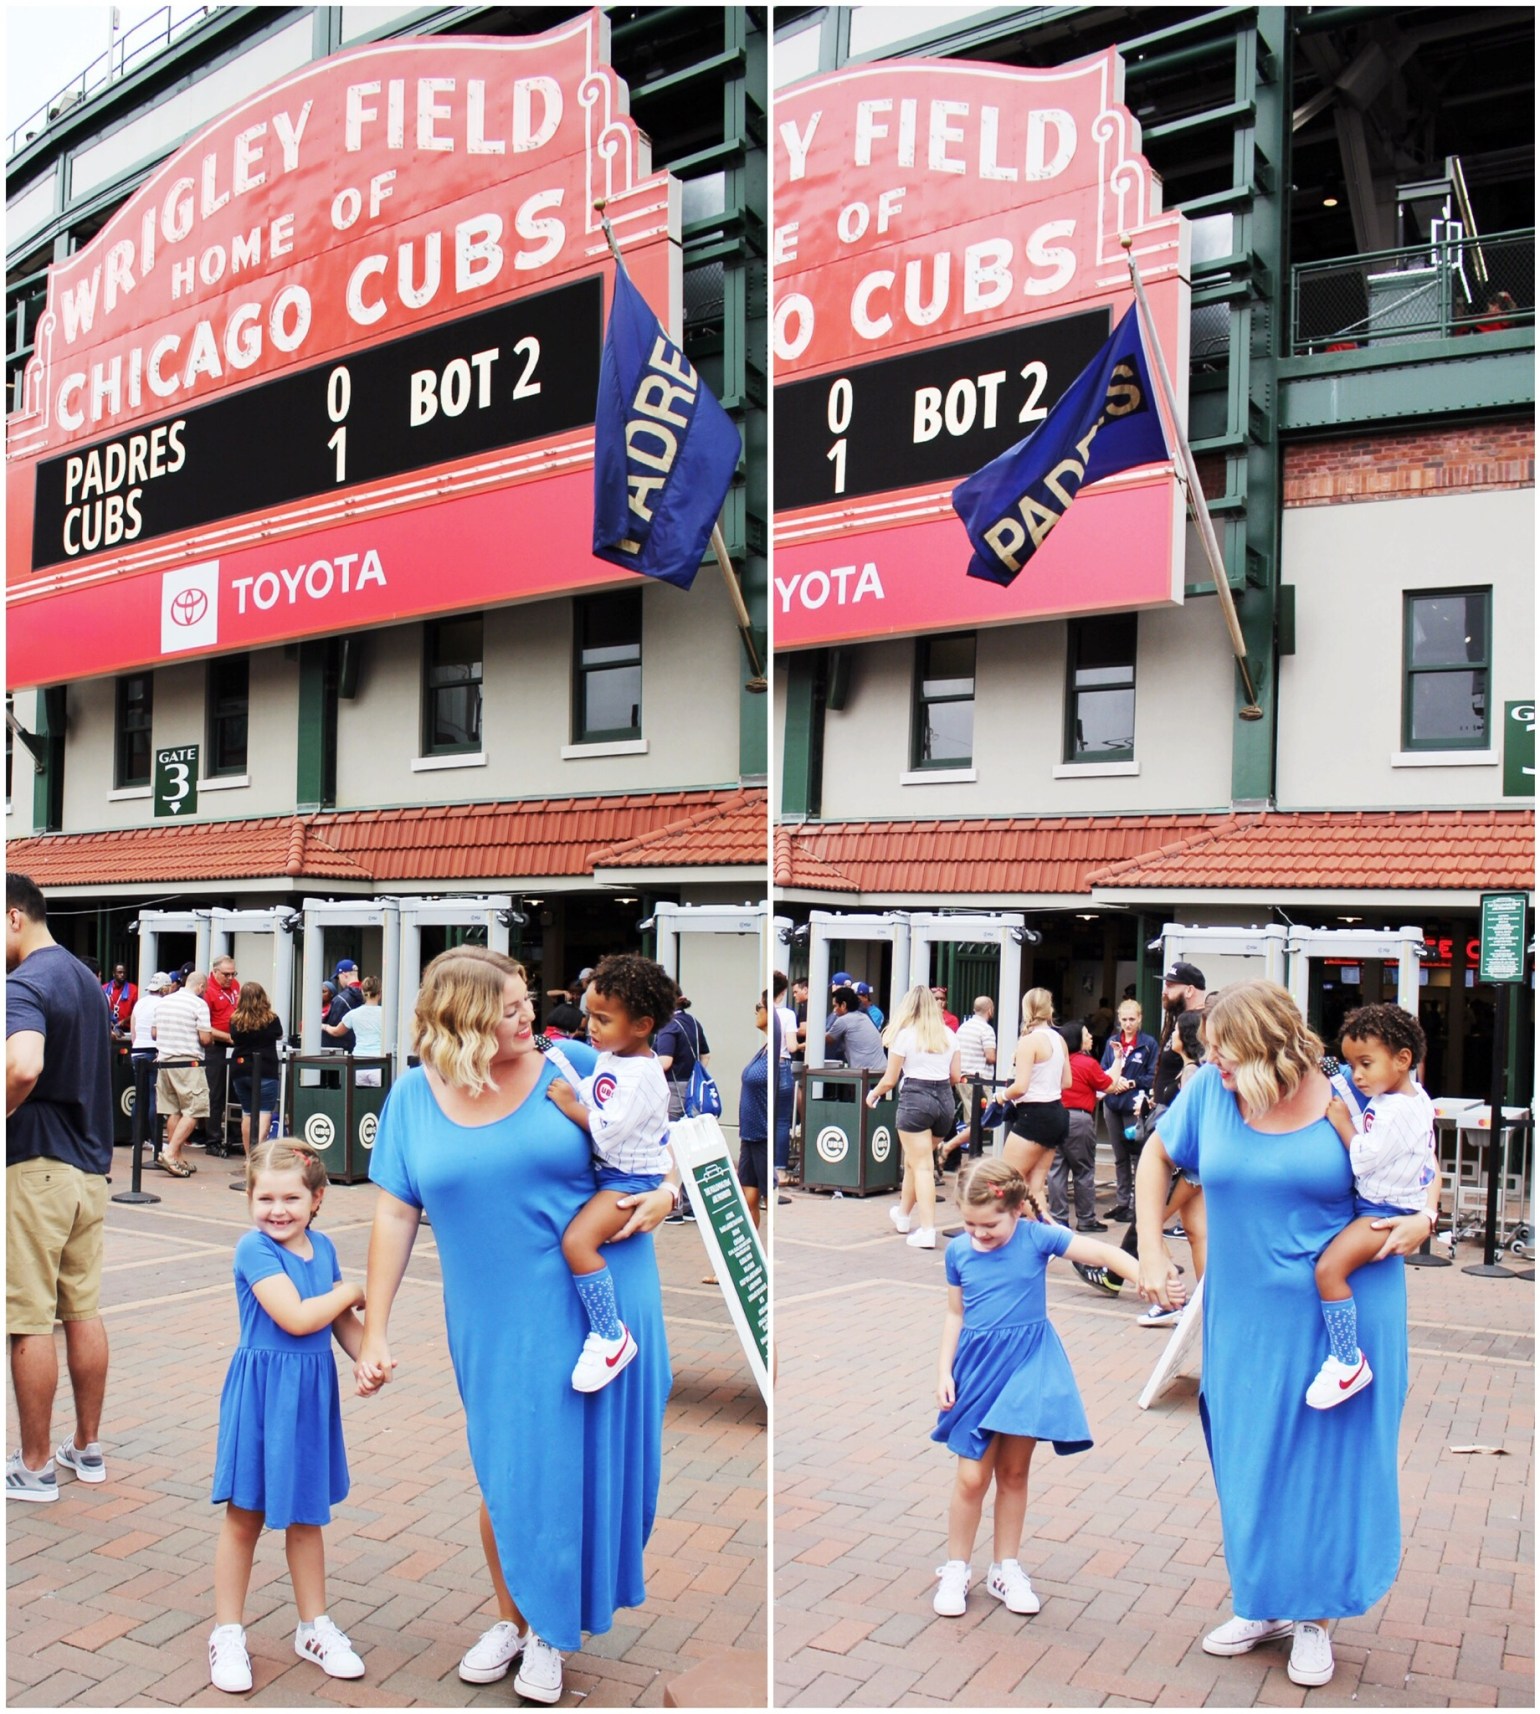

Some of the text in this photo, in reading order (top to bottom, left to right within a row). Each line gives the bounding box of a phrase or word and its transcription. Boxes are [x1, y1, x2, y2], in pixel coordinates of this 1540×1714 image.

[853, 98, 1078, 182] FIELD
[61, 75, 564, 345] WRIGLEY FIELD
[171, 168, 397, 300] HOME OF
[836, 186, 907, 244] OF
[55, 188, 567, 432] CHICAGO CUBS
[850, 219, 1077, 340] CUBS
[410, 336, 542, 428] BOT 2
[827, 377, 853, 434] 0
[913, 360, 1048, 444] BOT 2
[65, 365, 351, 506] PADRES 0
[614, 335, 699, 556] ADRE
[826, 438, 847, 494] 1
[983, 364, 1142, 573] PADS
[63, 426, 347, 556] CUBS 1
[231, 549, 388, 615] TOYOTA
[773, 562, 886, 613] YOTA
[158, 748, 197, 764] GATE
[162, 763, 190, 801] 3
